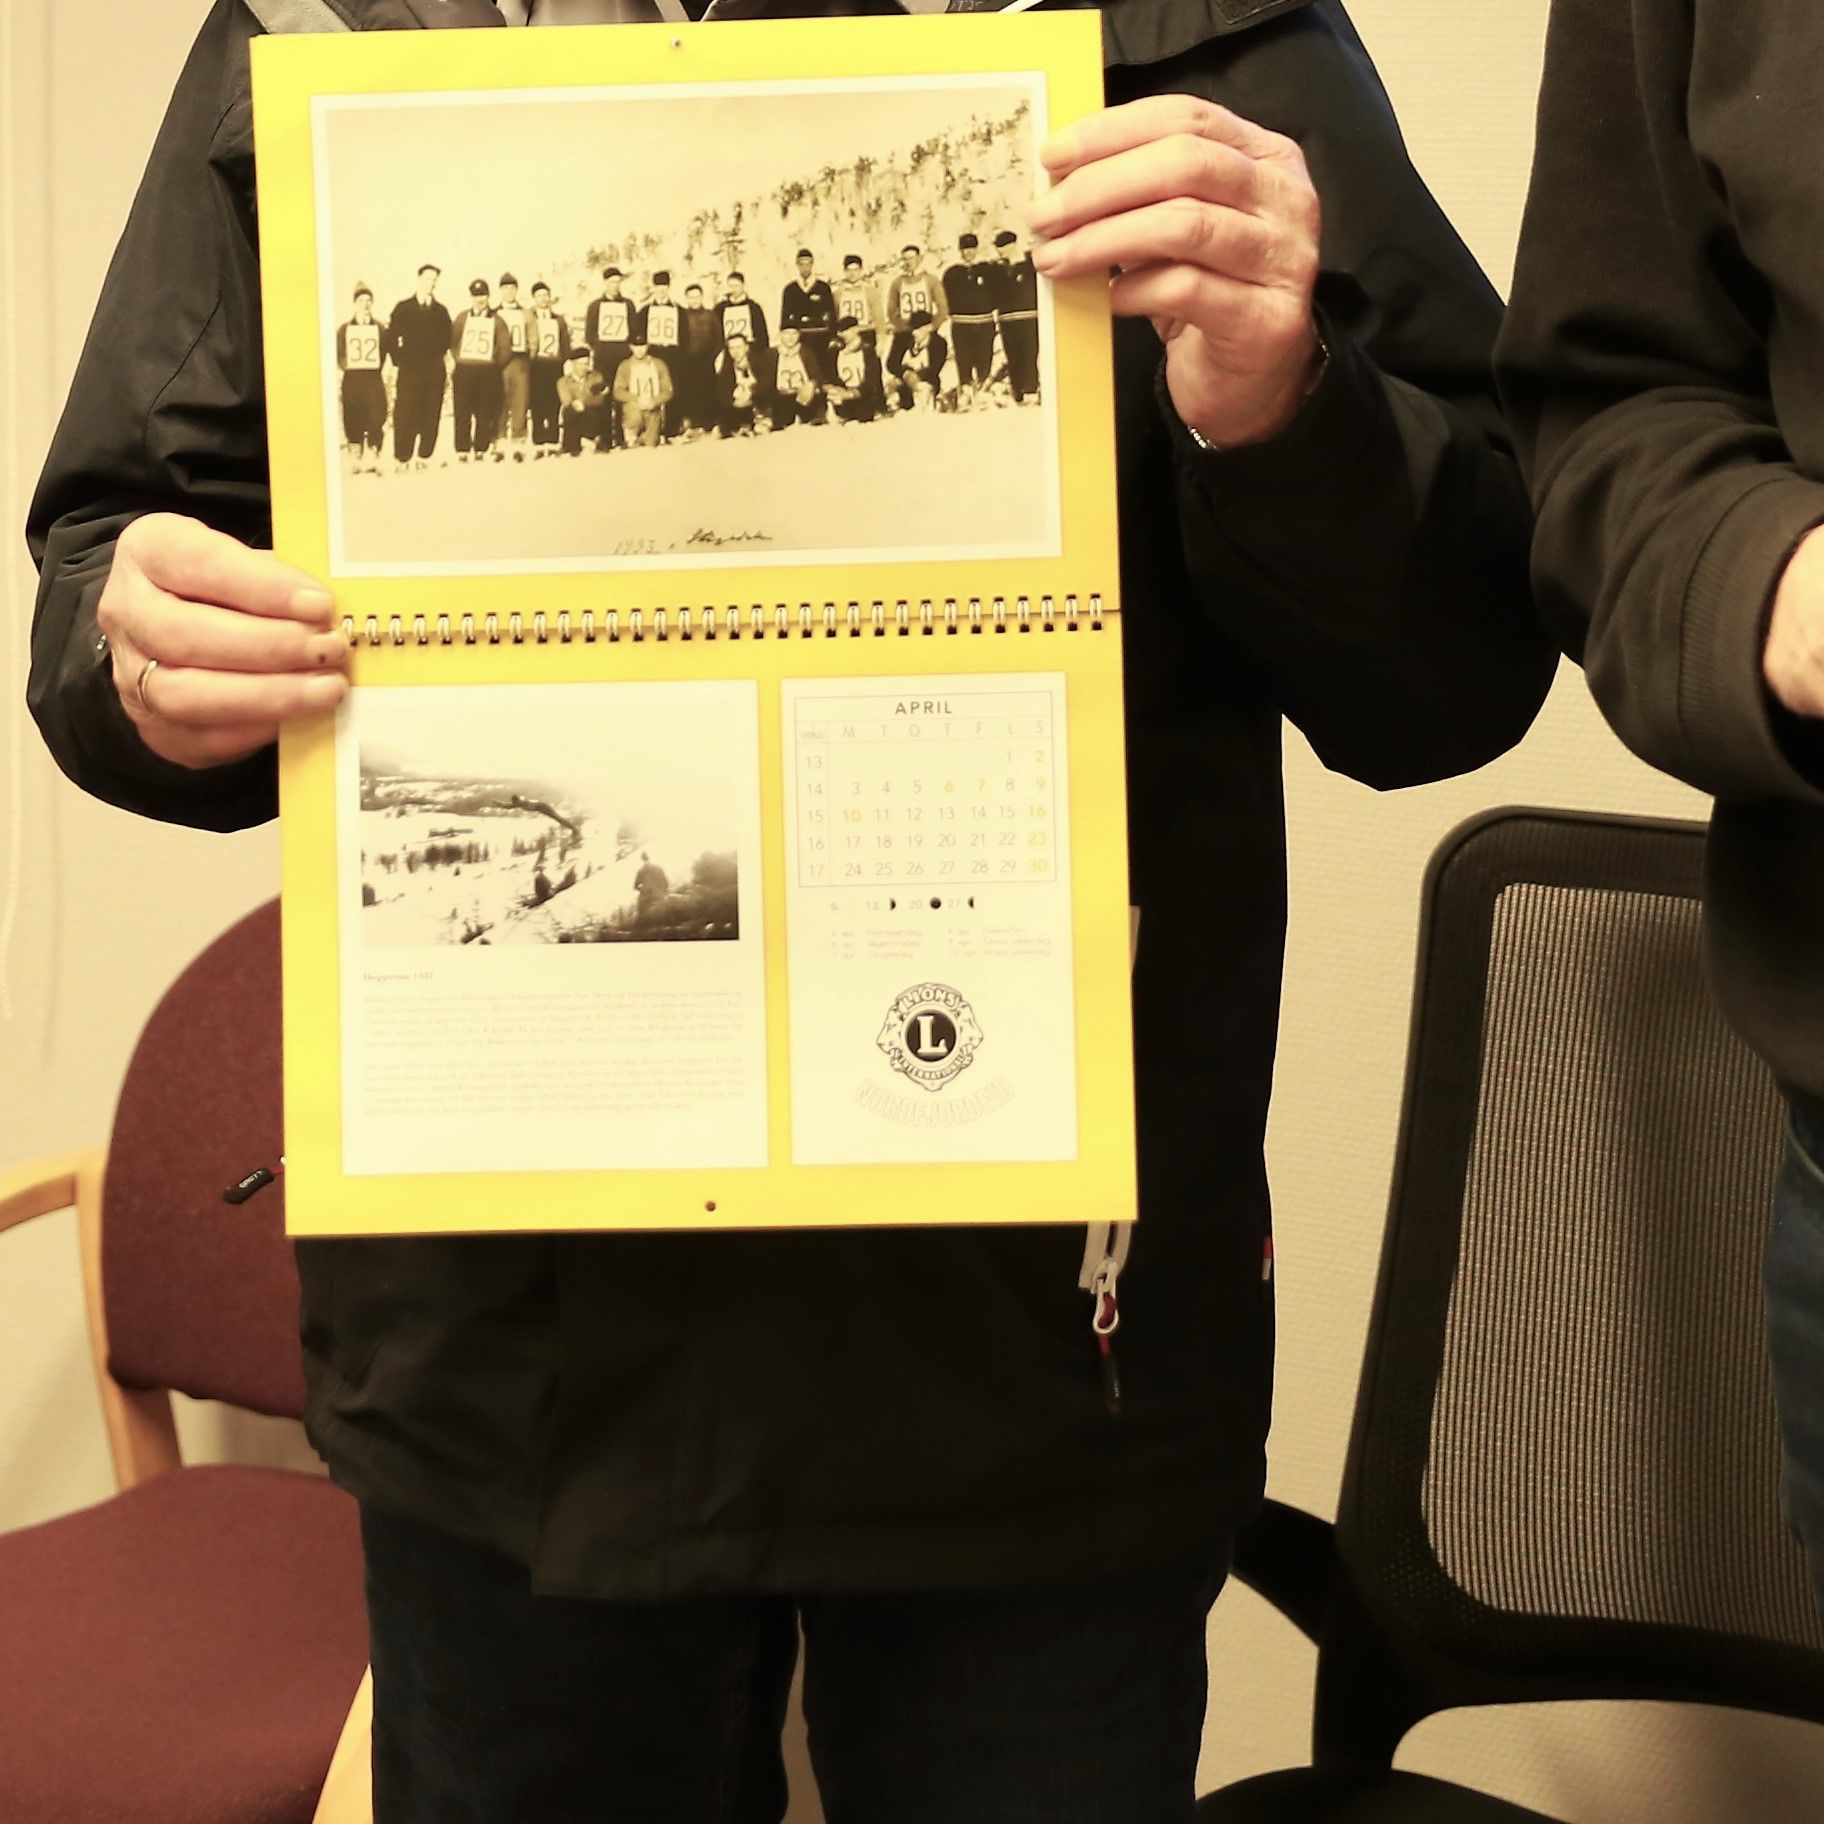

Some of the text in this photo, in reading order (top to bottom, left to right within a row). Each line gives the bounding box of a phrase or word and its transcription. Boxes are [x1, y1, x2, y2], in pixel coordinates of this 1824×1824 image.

[602, 315, 625, 336] 27
[648, 317, 674, 338] 36
[349, 338, 377, 362] 32
[463, 330, 490, 355] 25
[895, 700, 953, 715] APRIL
[808, 751, 1045, 768] 13 1 2
[808, 777, 1045, 795] 14 3 4 5 6 7 8 9
[808, 804, 1045, 823] 15 10 11 12 13 14 15 16
[808, 831, 1047, 850] 16 17 18 19 20 21 22 23
[809, 858, 1047, 877] 17 24 25 26 27 28 29 30
[902, 988, 959, 1010] LIONS
[917, 1015, 948, 1054] L
